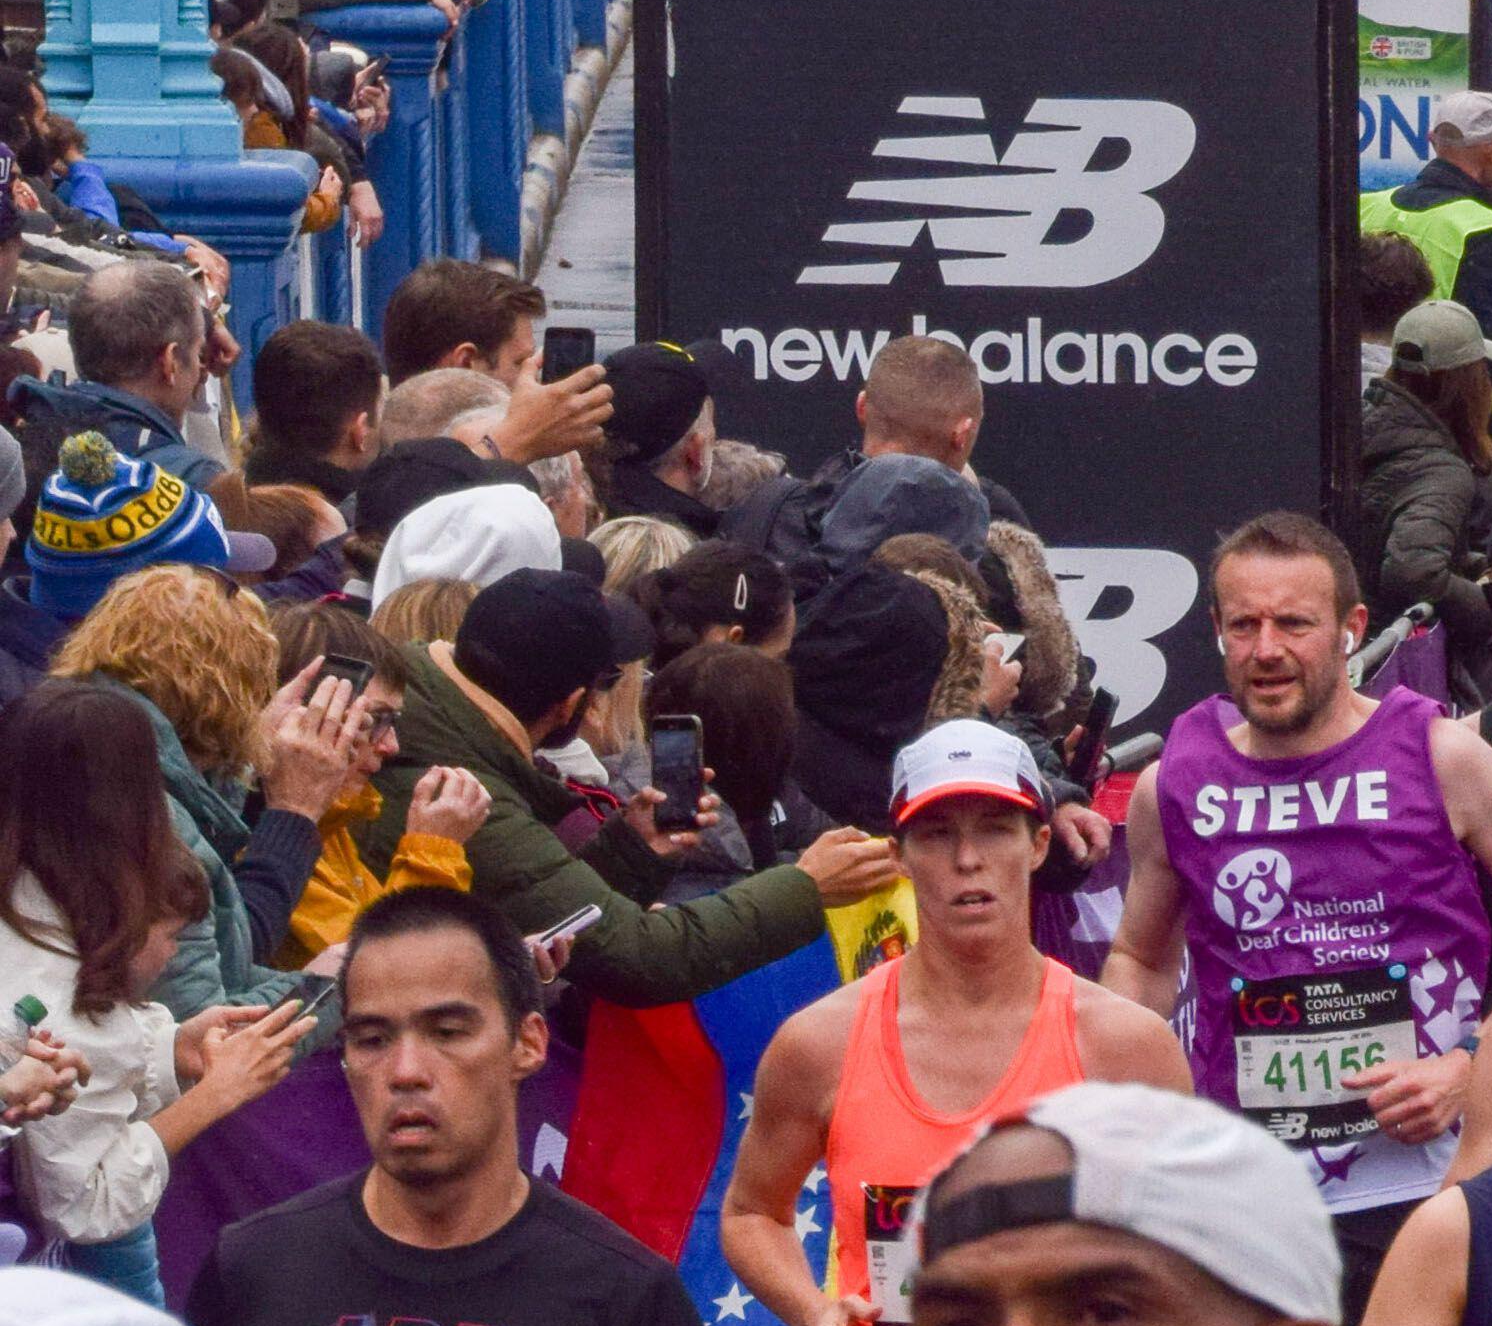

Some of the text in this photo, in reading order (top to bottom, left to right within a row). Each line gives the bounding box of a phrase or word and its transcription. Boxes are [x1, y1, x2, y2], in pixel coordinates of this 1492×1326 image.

[1387, 79, 1431, 88] WATER
[721, 326, 882, 382] new
[1192, 770, 1389, 838] STEVE
[1293, 892, 1385, 919] National
[1236, 919, 1389, 952] Deaf Children's
[1314, 944, 1389, 967] Society
[1304, 983, 1343, 996] TATA
[1305, 989, 1397, 1011] CONSULTANCY
[1238, 991, 1300, 1027] tcs
[1307, 1009, 1366, 1025] SERVICES
[1311, 1125, 1341, 1139] new
